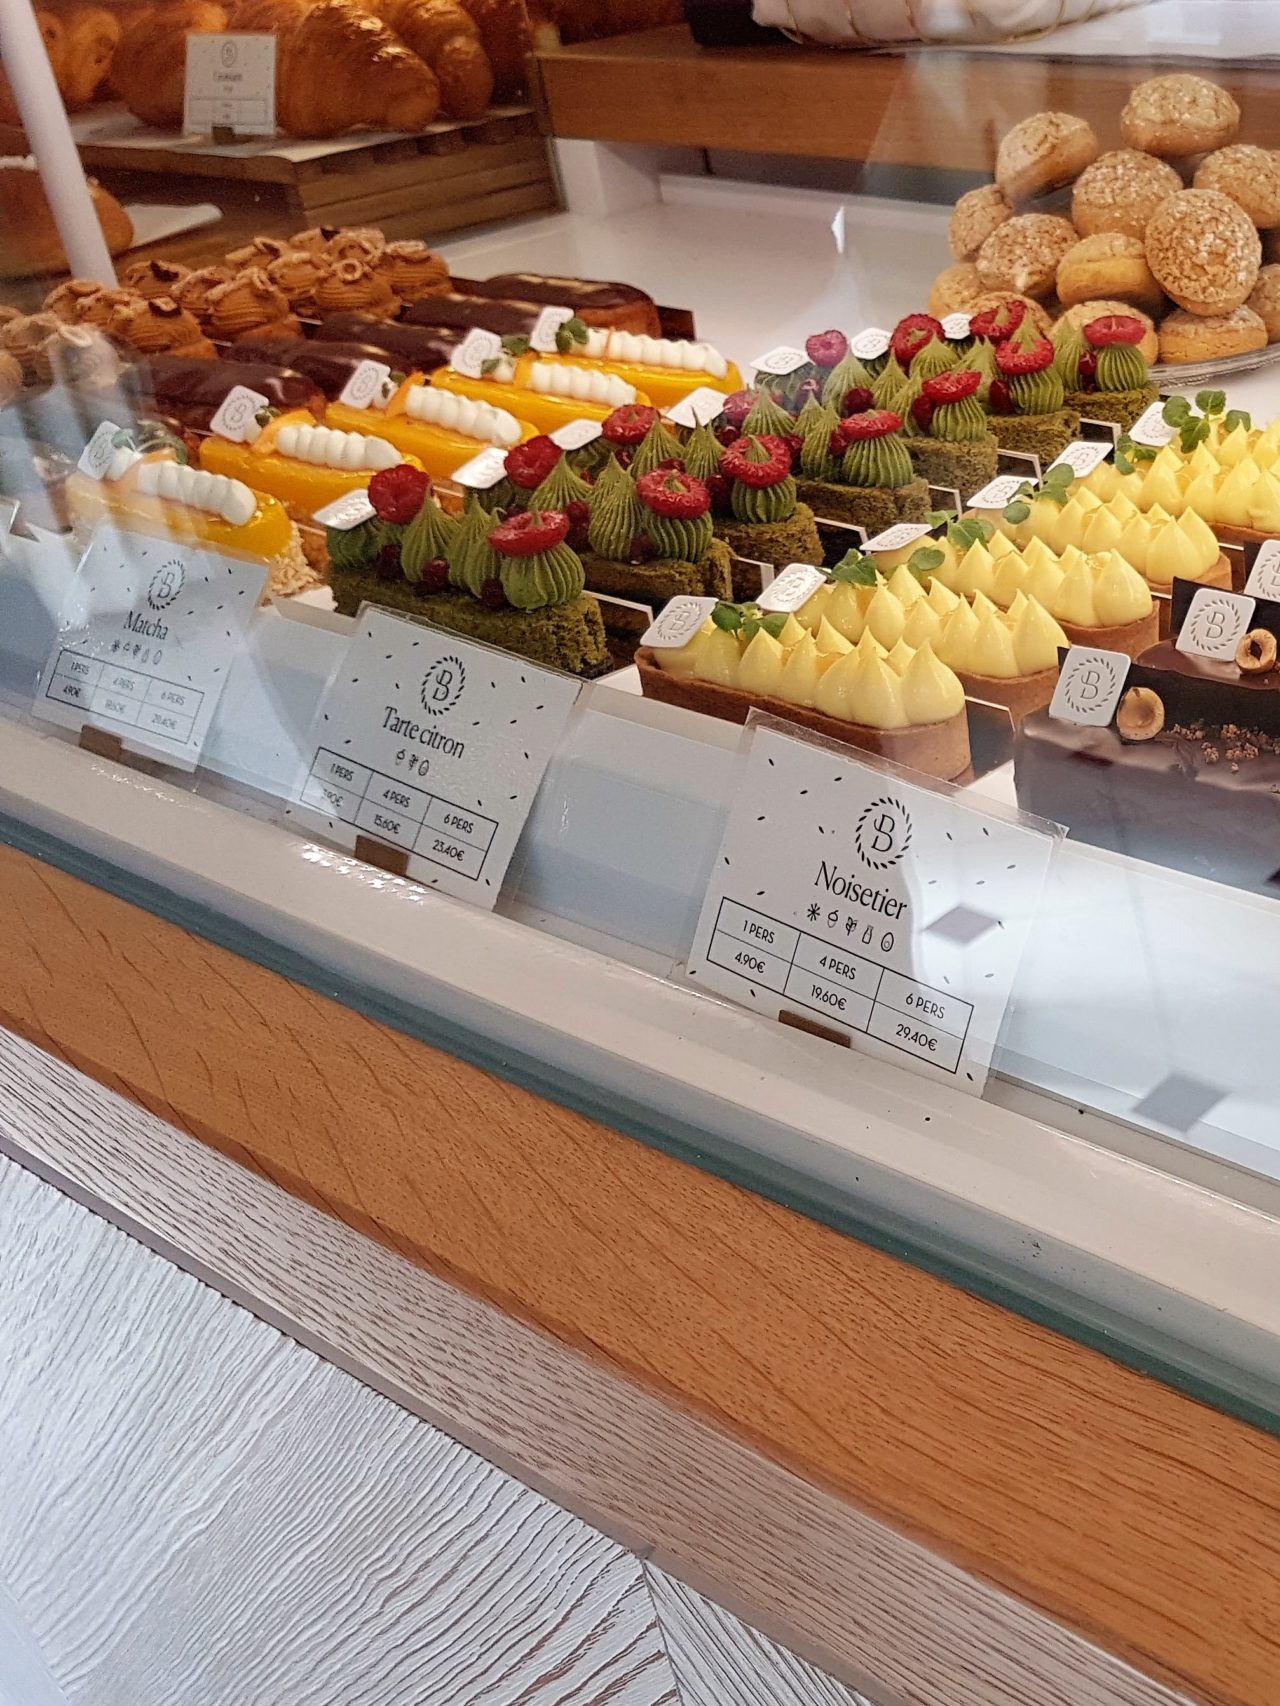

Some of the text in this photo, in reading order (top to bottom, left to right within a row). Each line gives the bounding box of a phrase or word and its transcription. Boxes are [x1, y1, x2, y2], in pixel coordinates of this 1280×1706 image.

[123, 610, 169, 641] Matcha
[1205, 611, 1226, 639] B
[432, 669, 454, 702] B
[1080, 670, 1100, 700] B
[382, 705, 465, 759] Tarte citron
[334, 765, 354, 782] PERS
[389, 791, 410, 808] PERS
[450, 816, 474, 834] PERS
[871, 814, 895, 852] B
[432, 839, 465, 862] 23.40€
[814, 860, 908, 921] Noisetier
[748, 922, 775, 944] PERS
[734, 951, 766, 974] 4.90€
[819, 956, 857, 980] 4 PERS
[811, 984, 848, 1011] 19.60€
[905, 993, 946, 1020] 6 PERS
[895, 1023, 938, 1052] 29.40€
